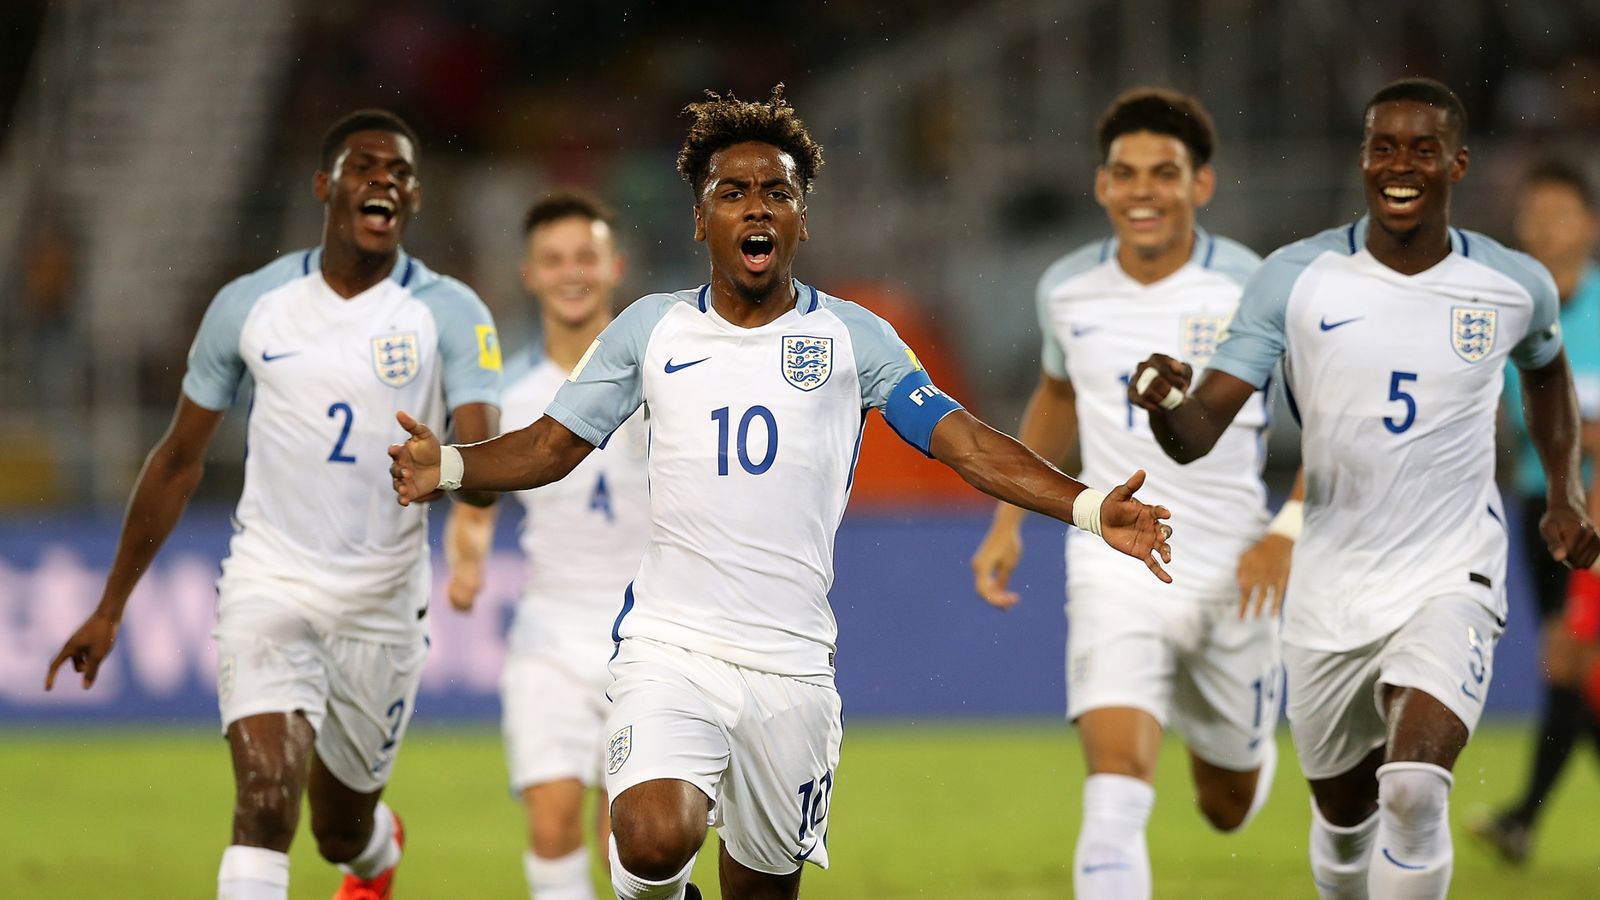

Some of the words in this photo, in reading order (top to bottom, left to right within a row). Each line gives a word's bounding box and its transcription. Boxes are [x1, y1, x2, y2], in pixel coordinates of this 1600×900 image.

[327, 402, 357, 464] 2
[1383, 371, 1418, 434] 5
[711, 404, 779, 476] 10
[381, 698, 405, 751] 2
[798, 768, 832, 842] 10
